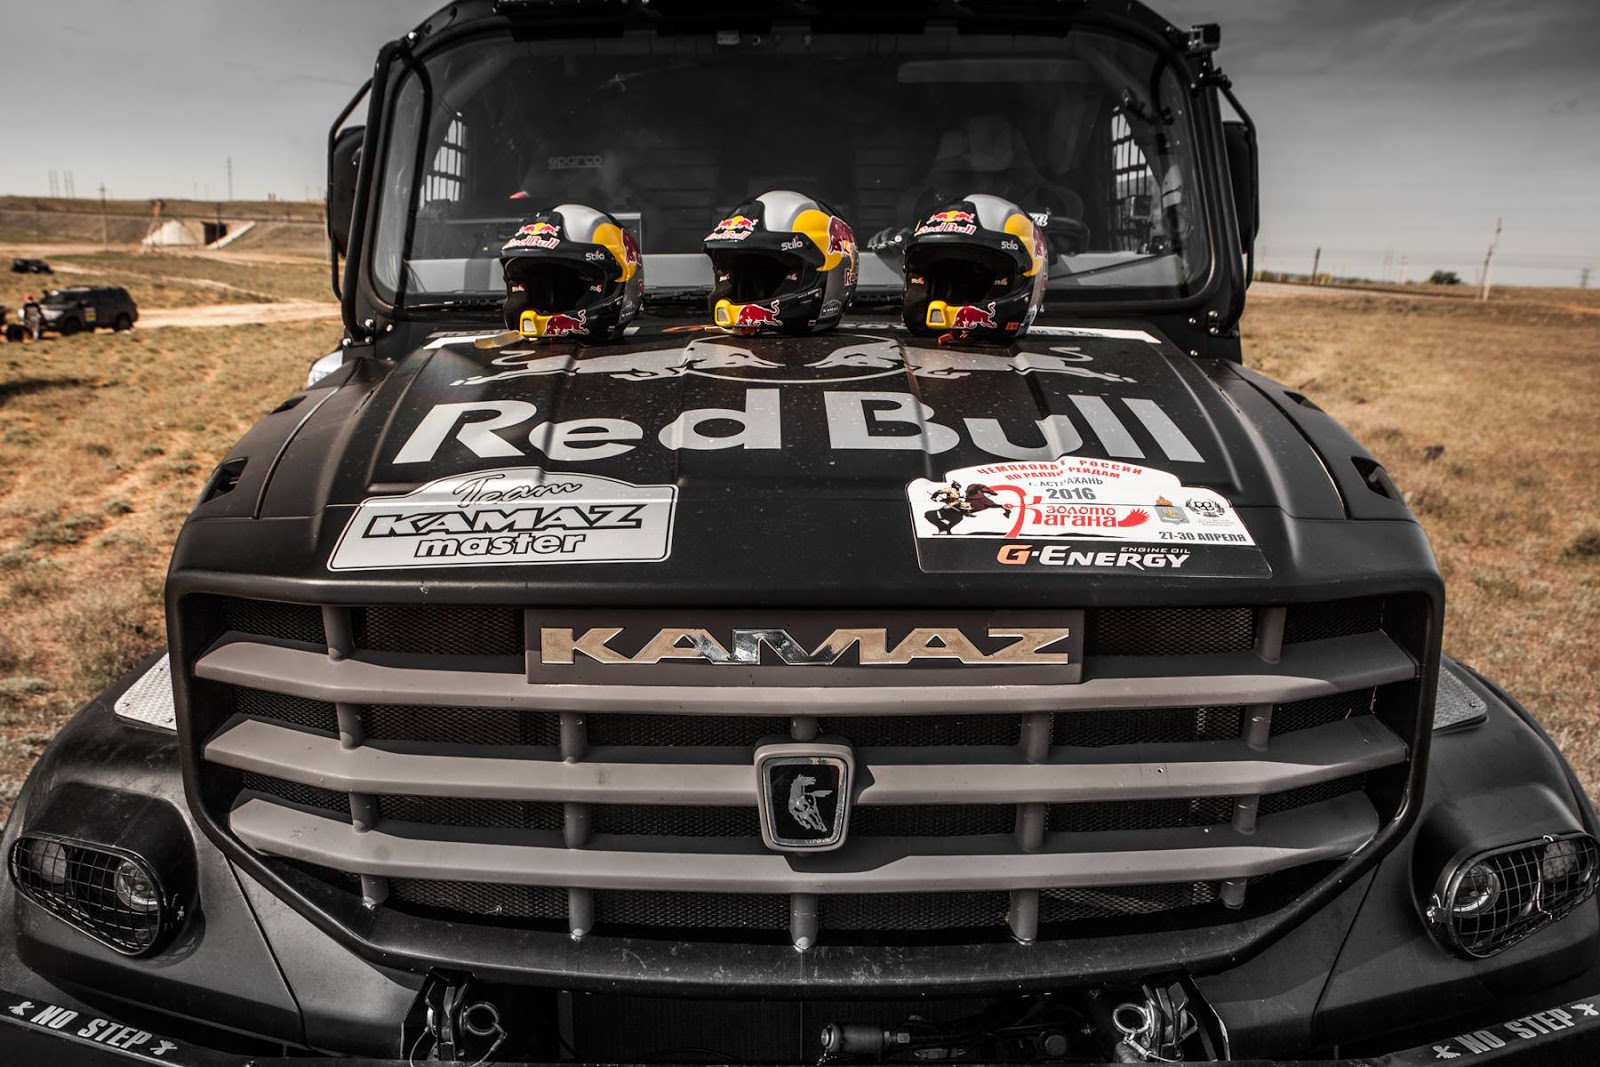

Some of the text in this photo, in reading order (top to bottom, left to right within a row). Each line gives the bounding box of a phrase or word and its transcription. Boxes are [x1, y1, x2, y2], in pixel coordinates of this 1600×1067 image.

[944, 223, 977, 235] Bull
[529, 236, 560, 249] Bull
[781, 237, 803, 251] Stilo
[1001, 239, 1018, 251] Stilo
[585, 250, 605, 261] Stilo
[392, 388, 1206, 464] Red Bull
[1079, 459, 1143, 476] РОССИИ
[1039, 476, 1104, 488] АСТРАХАНЬ
[452, 473, 583, 508] Team
[1045, 487, 1097, 501] 2016
[361, 503, 648, 539] KAMAZ
[1158, 531, 1247, 542] 27-30 АПРЕЛЯ
[414, 531, 586, 558] master
[1120, 546, 1168, 554] ENGINE
[541, 627, 1070, 666] KAMAZ
[30, 1005, 153, 1049] NO STEP
[1454, 1008, 1576, 1055] NO STEP
